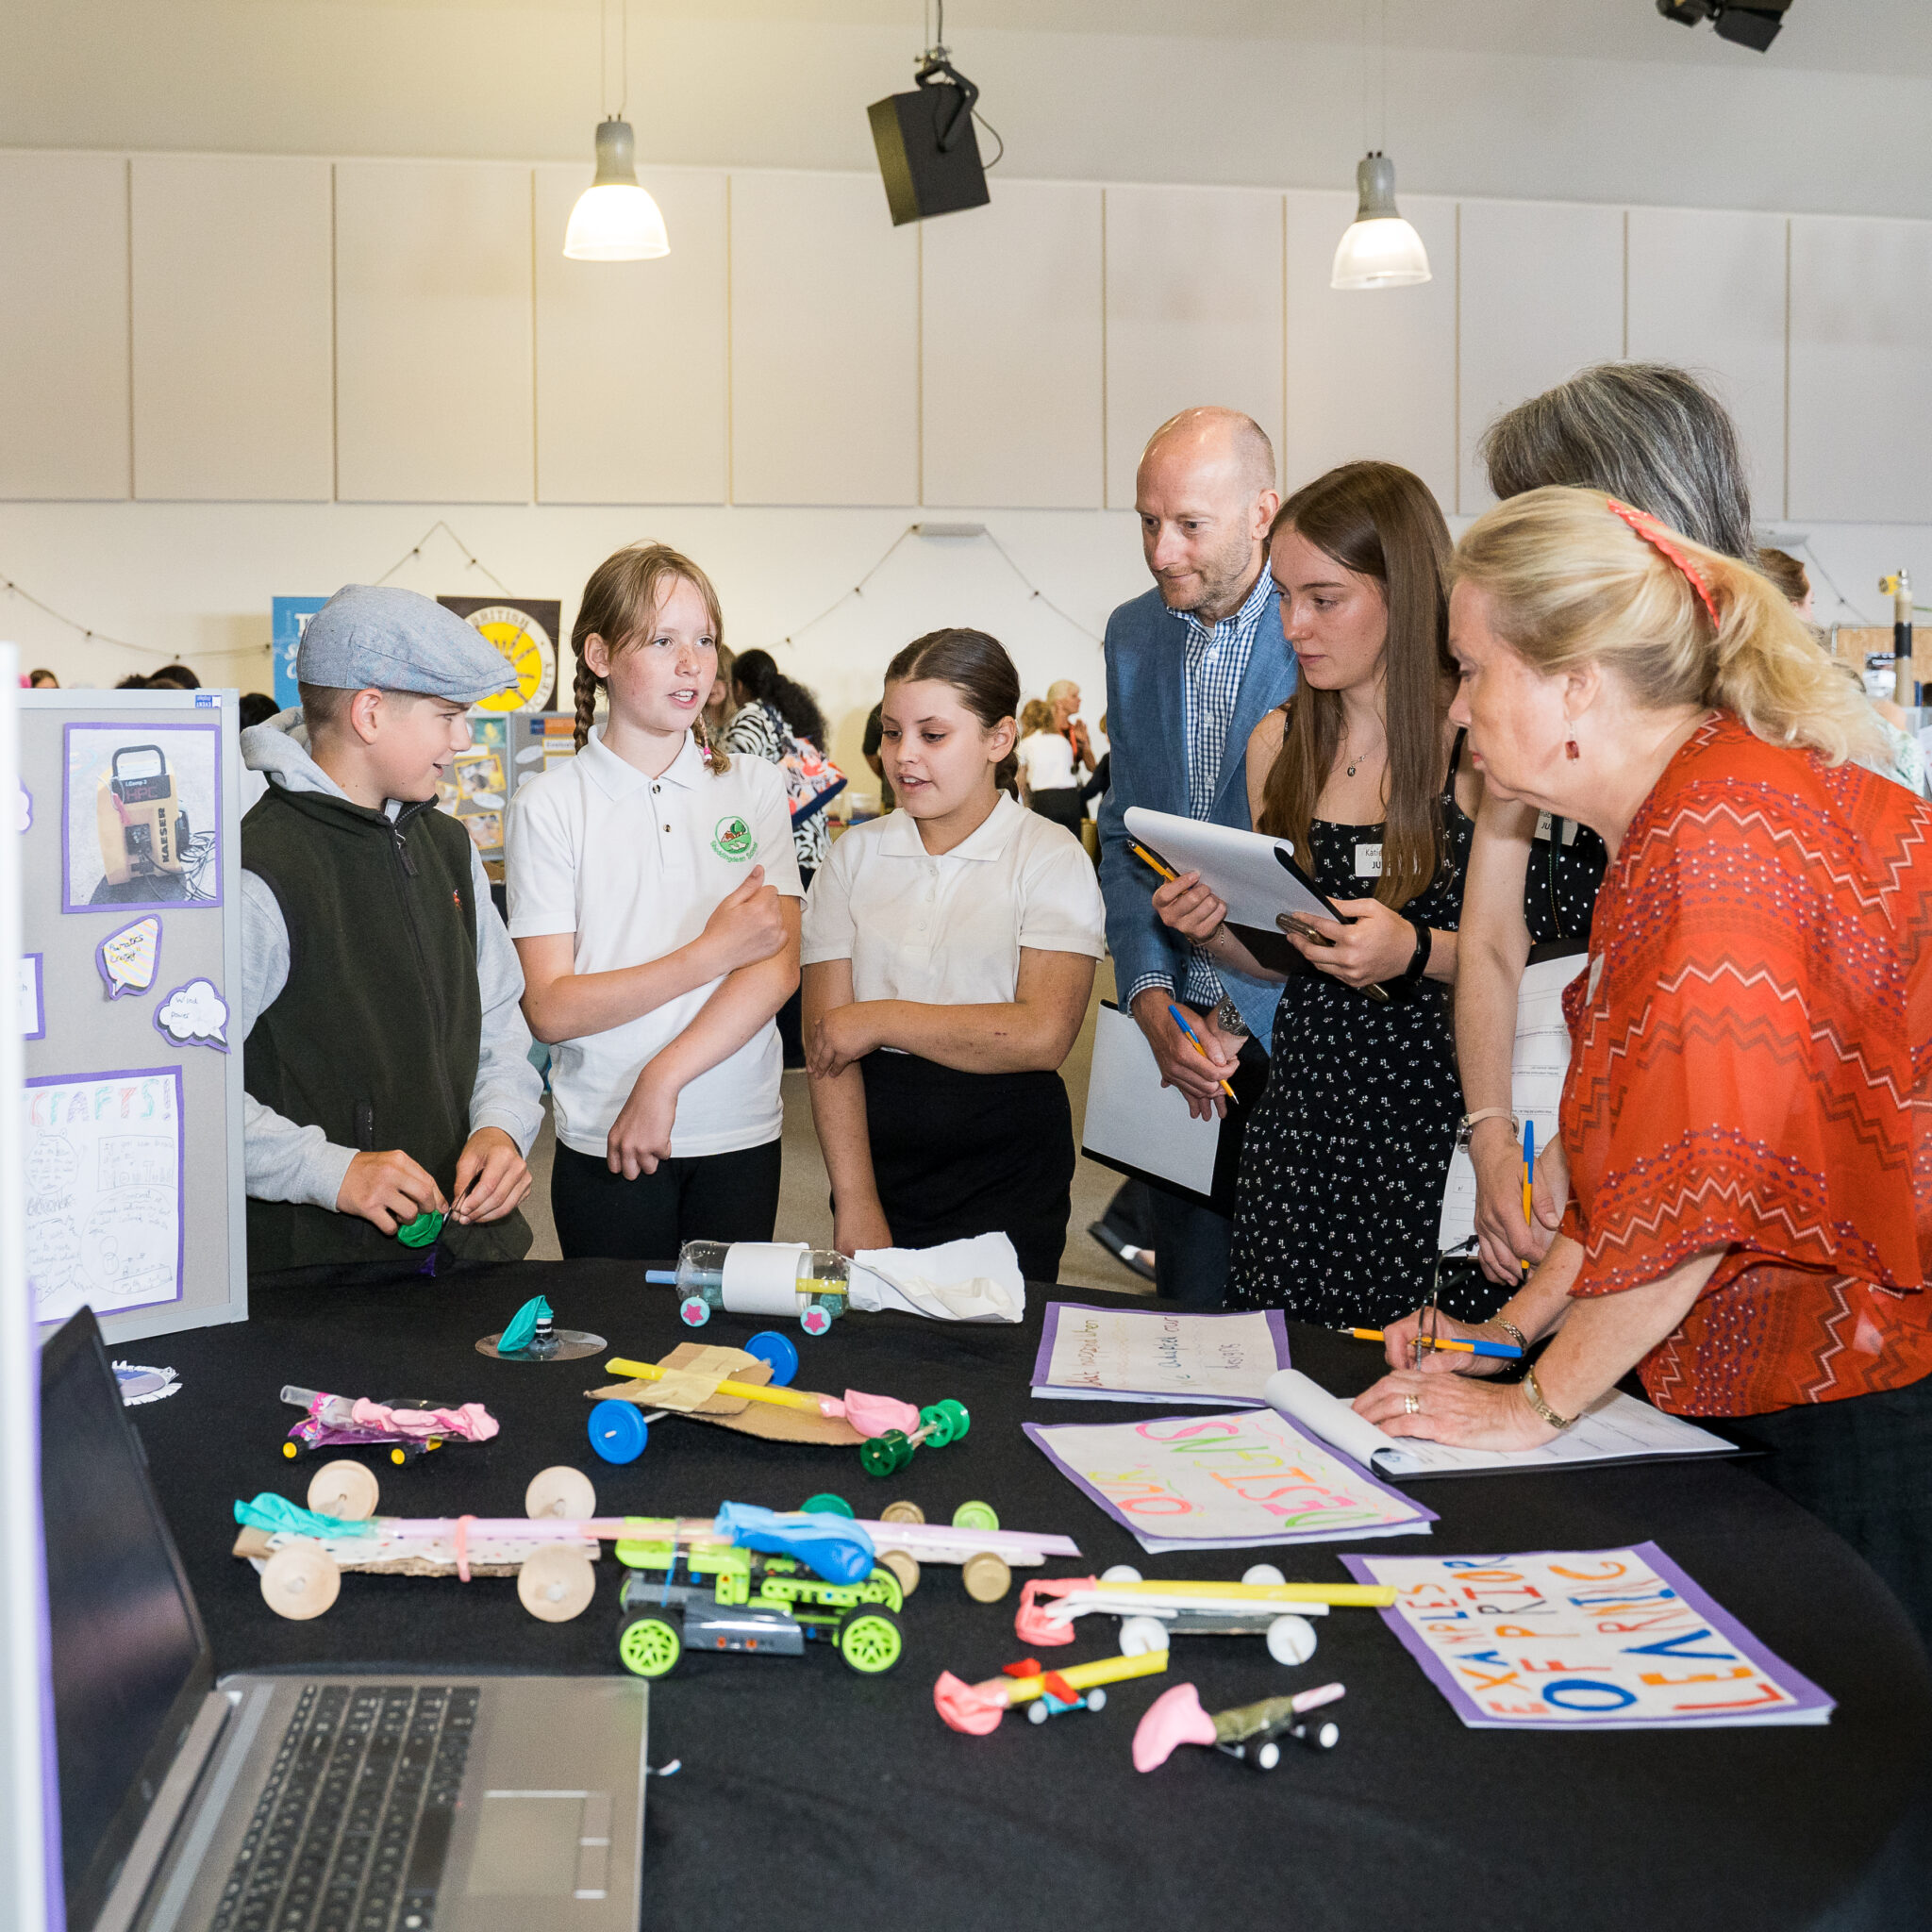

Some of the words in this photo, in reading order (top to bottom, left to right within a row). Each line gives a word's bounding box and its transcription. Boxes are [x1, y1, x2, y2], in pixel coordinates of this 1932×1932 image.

[158, 808, 169, 862] KAESER
[23, 1078, 171, 1126] CRAFTS!
[1088, 1468, 1193, 1516] OUR
[1135, 1420, 1387, 1528] DESIGNS
[1441, 1556, 1580, 1639] PRIOR
[1405, 1583, 1550, 1715] EXAMPLES
[1547, 1560, 1785, 1711] LEARNING
[1520, 1657, 1638, 1713] OF
